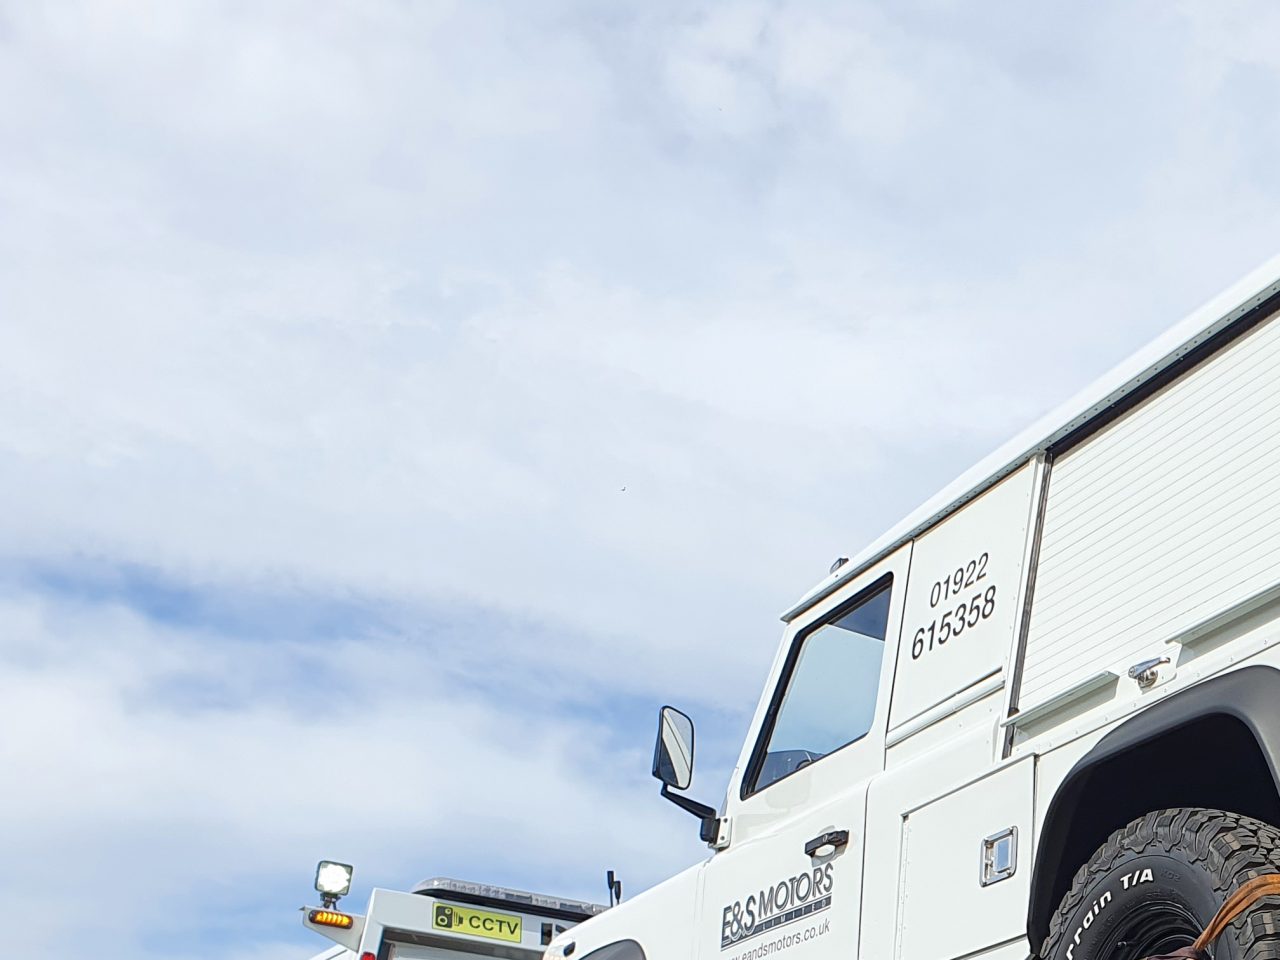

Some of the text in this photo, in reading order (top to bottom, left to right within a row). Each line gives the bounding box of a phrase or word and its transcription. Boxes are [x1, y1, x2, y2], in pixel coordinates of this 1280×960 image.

[930, 552, 989, 608] 01922
[911, 585, 997, 660] 615358
[758, 862, 834, 920] MOTORS
[1119, 868, 1154, 890] T/A
[468, 915, 519, 935] CCTV
[761, 899, 828, 931] LIMITED
